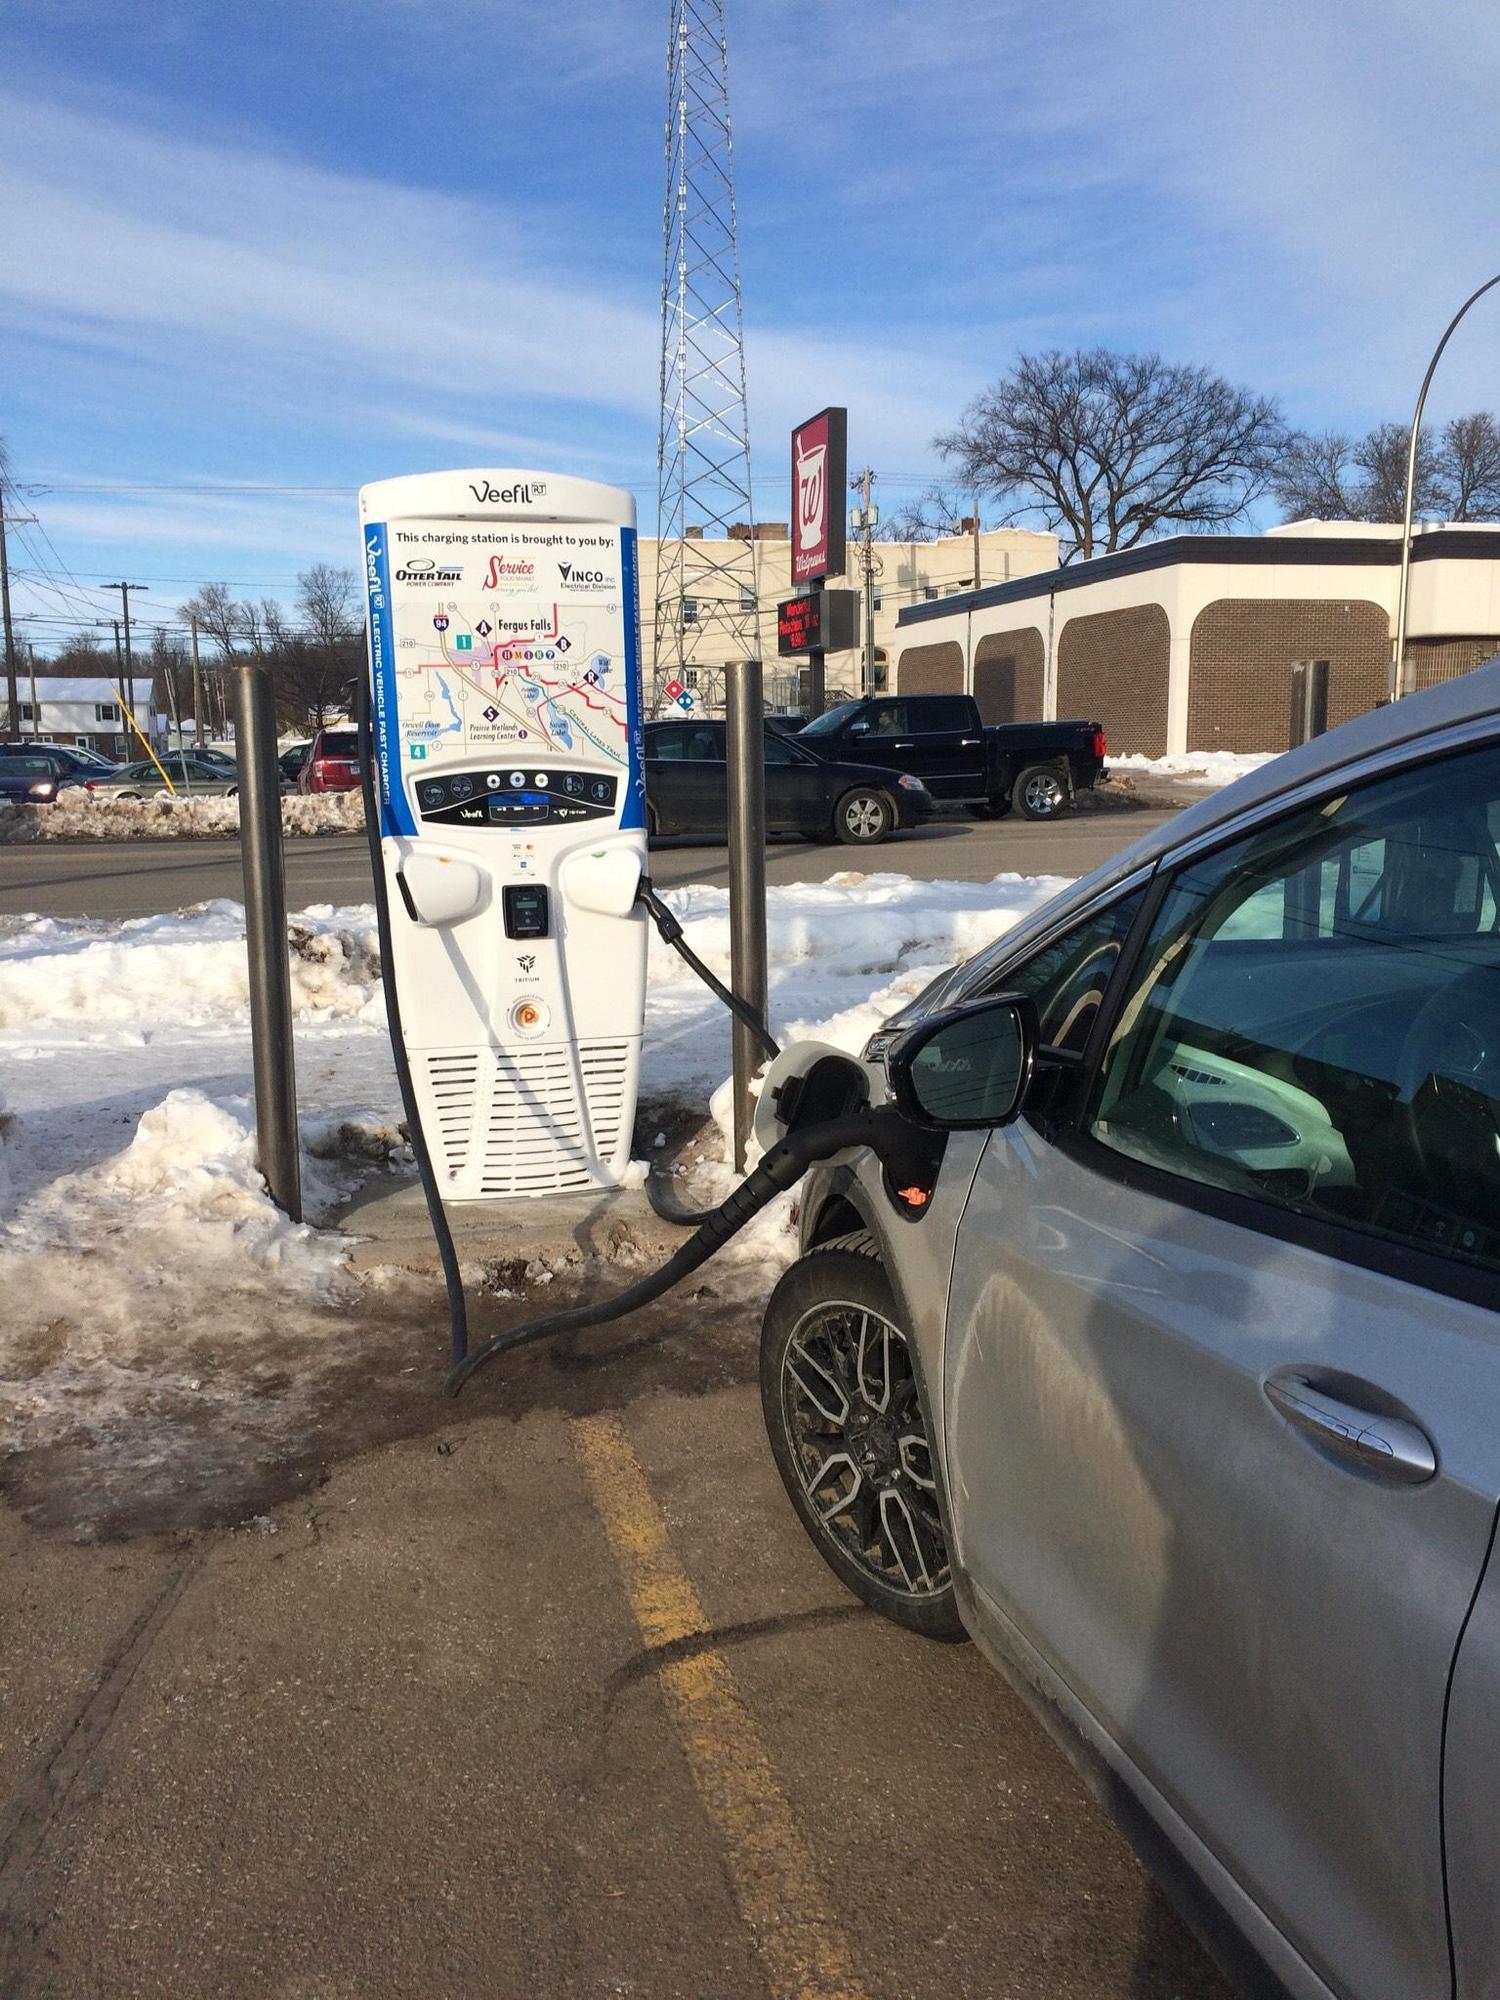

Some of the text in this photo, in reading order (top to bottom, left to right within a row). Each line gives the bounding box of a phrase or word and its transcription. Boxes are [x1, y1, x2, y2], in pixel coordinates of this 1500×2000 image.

[469, 481, 546, 503] Veefil RT
[396, 533, 614, 548] This charging station is brought to you by:
[367, 535, 382, 597] Veefil
[795, 551, 826, 575] Walgreens
[436, 570, 462, 581] TAIL
[482, 554, 535, 591] Service
[557, 562, 604, 582] VINCO
[560, 582, 591, 590] Electrical
[435, 619, 447, 629] 94
[480, 621, 489, 634] A
[498, 619, 552, 633] Fergus Falls
[373, 613, 383, 669] ELECTRIC
[461, 636, 467, 648] 1
[560, 639, 567, 650] B
[587, 671, 595, 683] R
[375, 672, 385, 718] VEHICLE
[487, 708, 494, 720] S
[470, 723, 518, 731] Prairie Wetlands
[379, 721, 388, 749] FAST
[470, 732, 516, 742] Learning Center
[414, 746, 421, 758] 4
[381, 751, 390, 805] CHARGER
